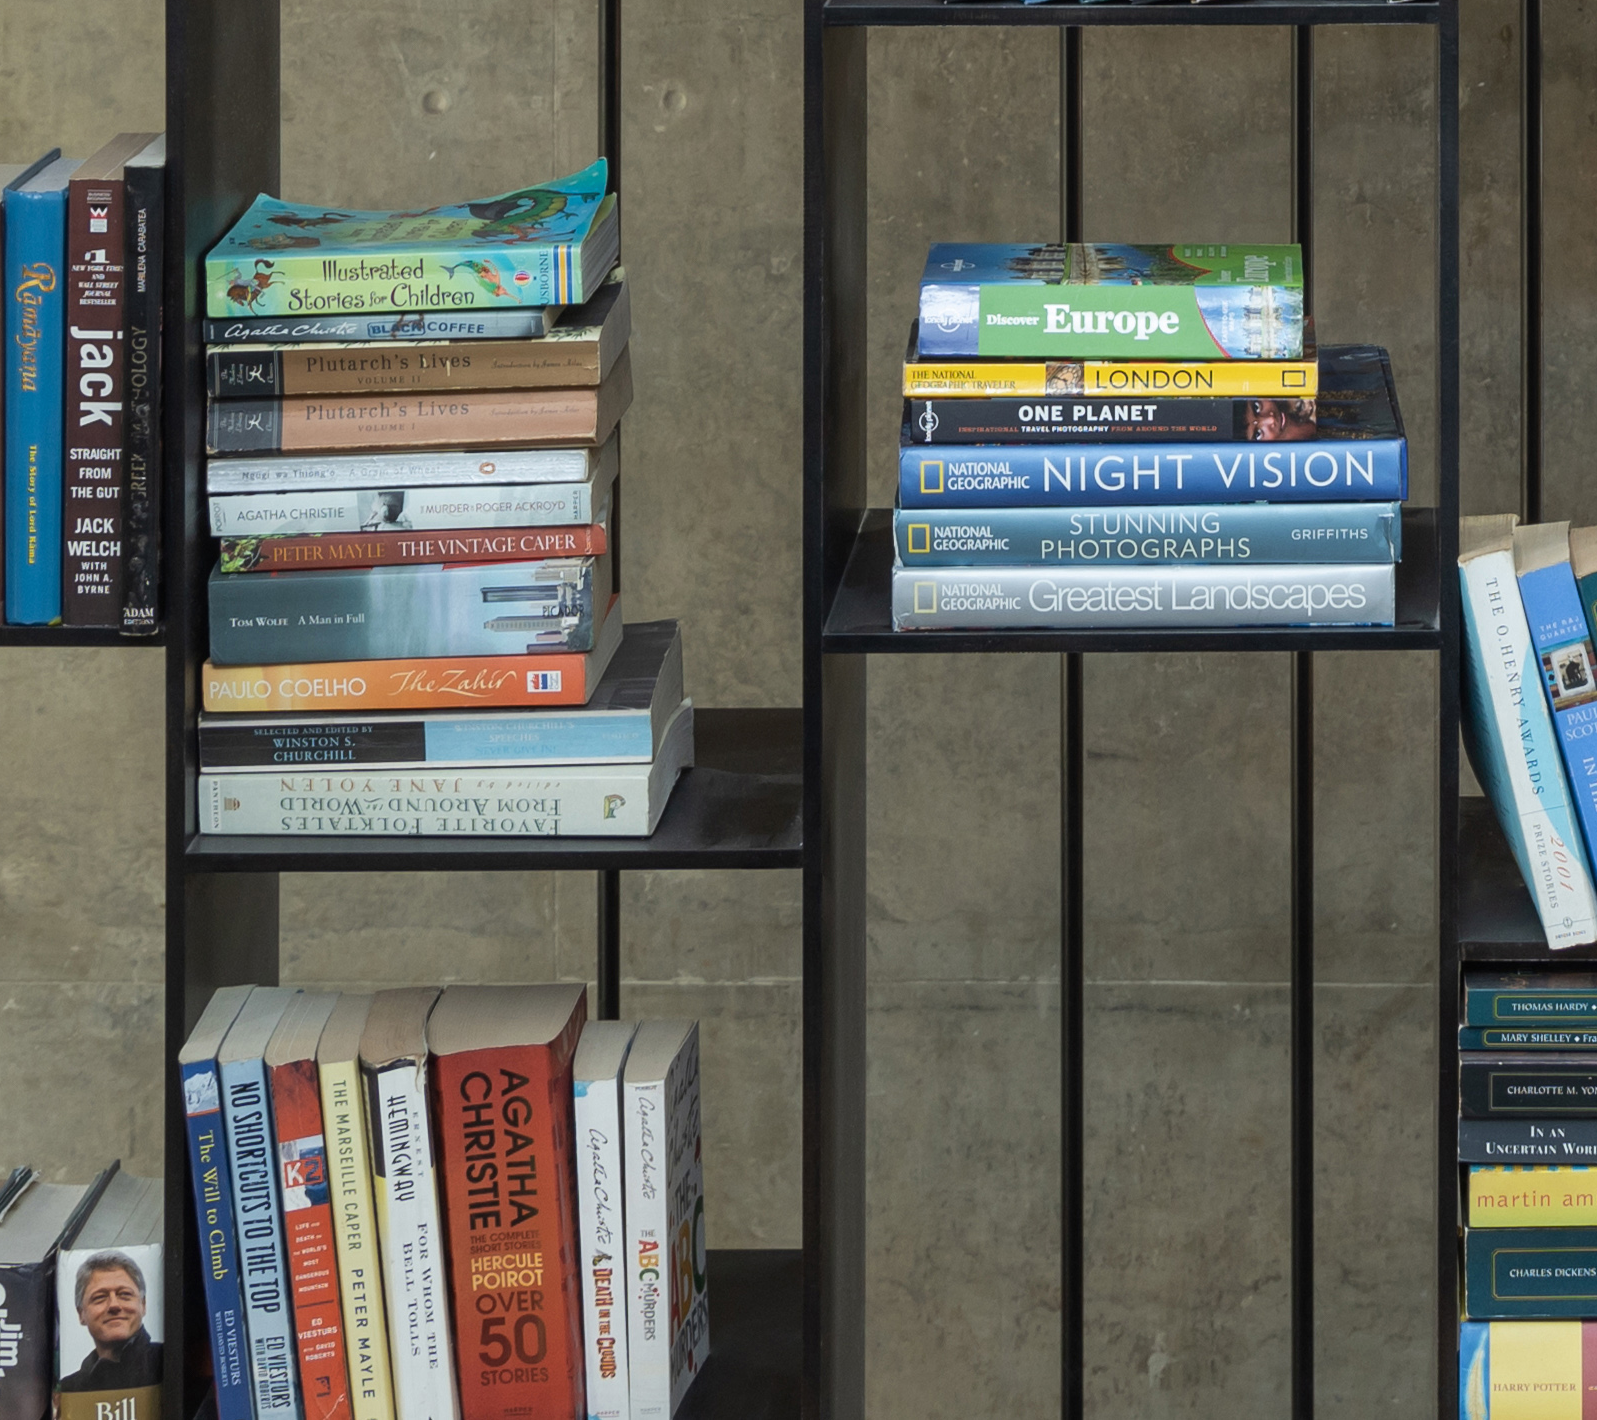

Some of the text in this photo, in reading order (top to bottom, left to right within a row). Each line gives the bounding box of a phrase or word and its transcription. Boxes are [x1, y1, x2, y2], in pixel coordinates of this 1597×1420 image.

[323, 259, 424, 283] Illustrated
[288, 285, 474, 311] Stories for Children
[986, 305, 1179, 339] Discover Europe
[306, 354, 471, 373] Plutarch's Lives
[71, 327, 123, 427] jack
[1096, 370, 1213, 390] LONDON
[1018, 405, 1157, 421] ONE PLANET
[1044, 451, 1374, 491] NIGHT VISION
[74, 518, 113, 534] JACK
[1292, 529, 1368, 540] GRIFFITHS
[68, 541, 121, 556] WELCH
[398, 534, 576, 558] THE VINTAGE CAPER
[1029, 580, 1366, 616] Greatest Landscapes
[210, 678, 366, 699] PAULO COELHO
[1501, 1033, 1571, 1043] MARY SHELLEY
[387, 1095, 415, 1203] HEMINGWAY
[460, 1070, 501, 1231] CHRISTIE
[500, 1069, 539, 1228] AGATHA
[470, 1253, 543, 1272] HERCULE
[472, 1270, 543, 1290] POIROT
[476, 1292, 543, 1312] OVER
[0, 1320, 24, 1367] Jim
[479, 1314, 548, 1367] 50
[481, 1368, 548, 1386] STORIES
[96, 1398, 136, 1420] Bill
